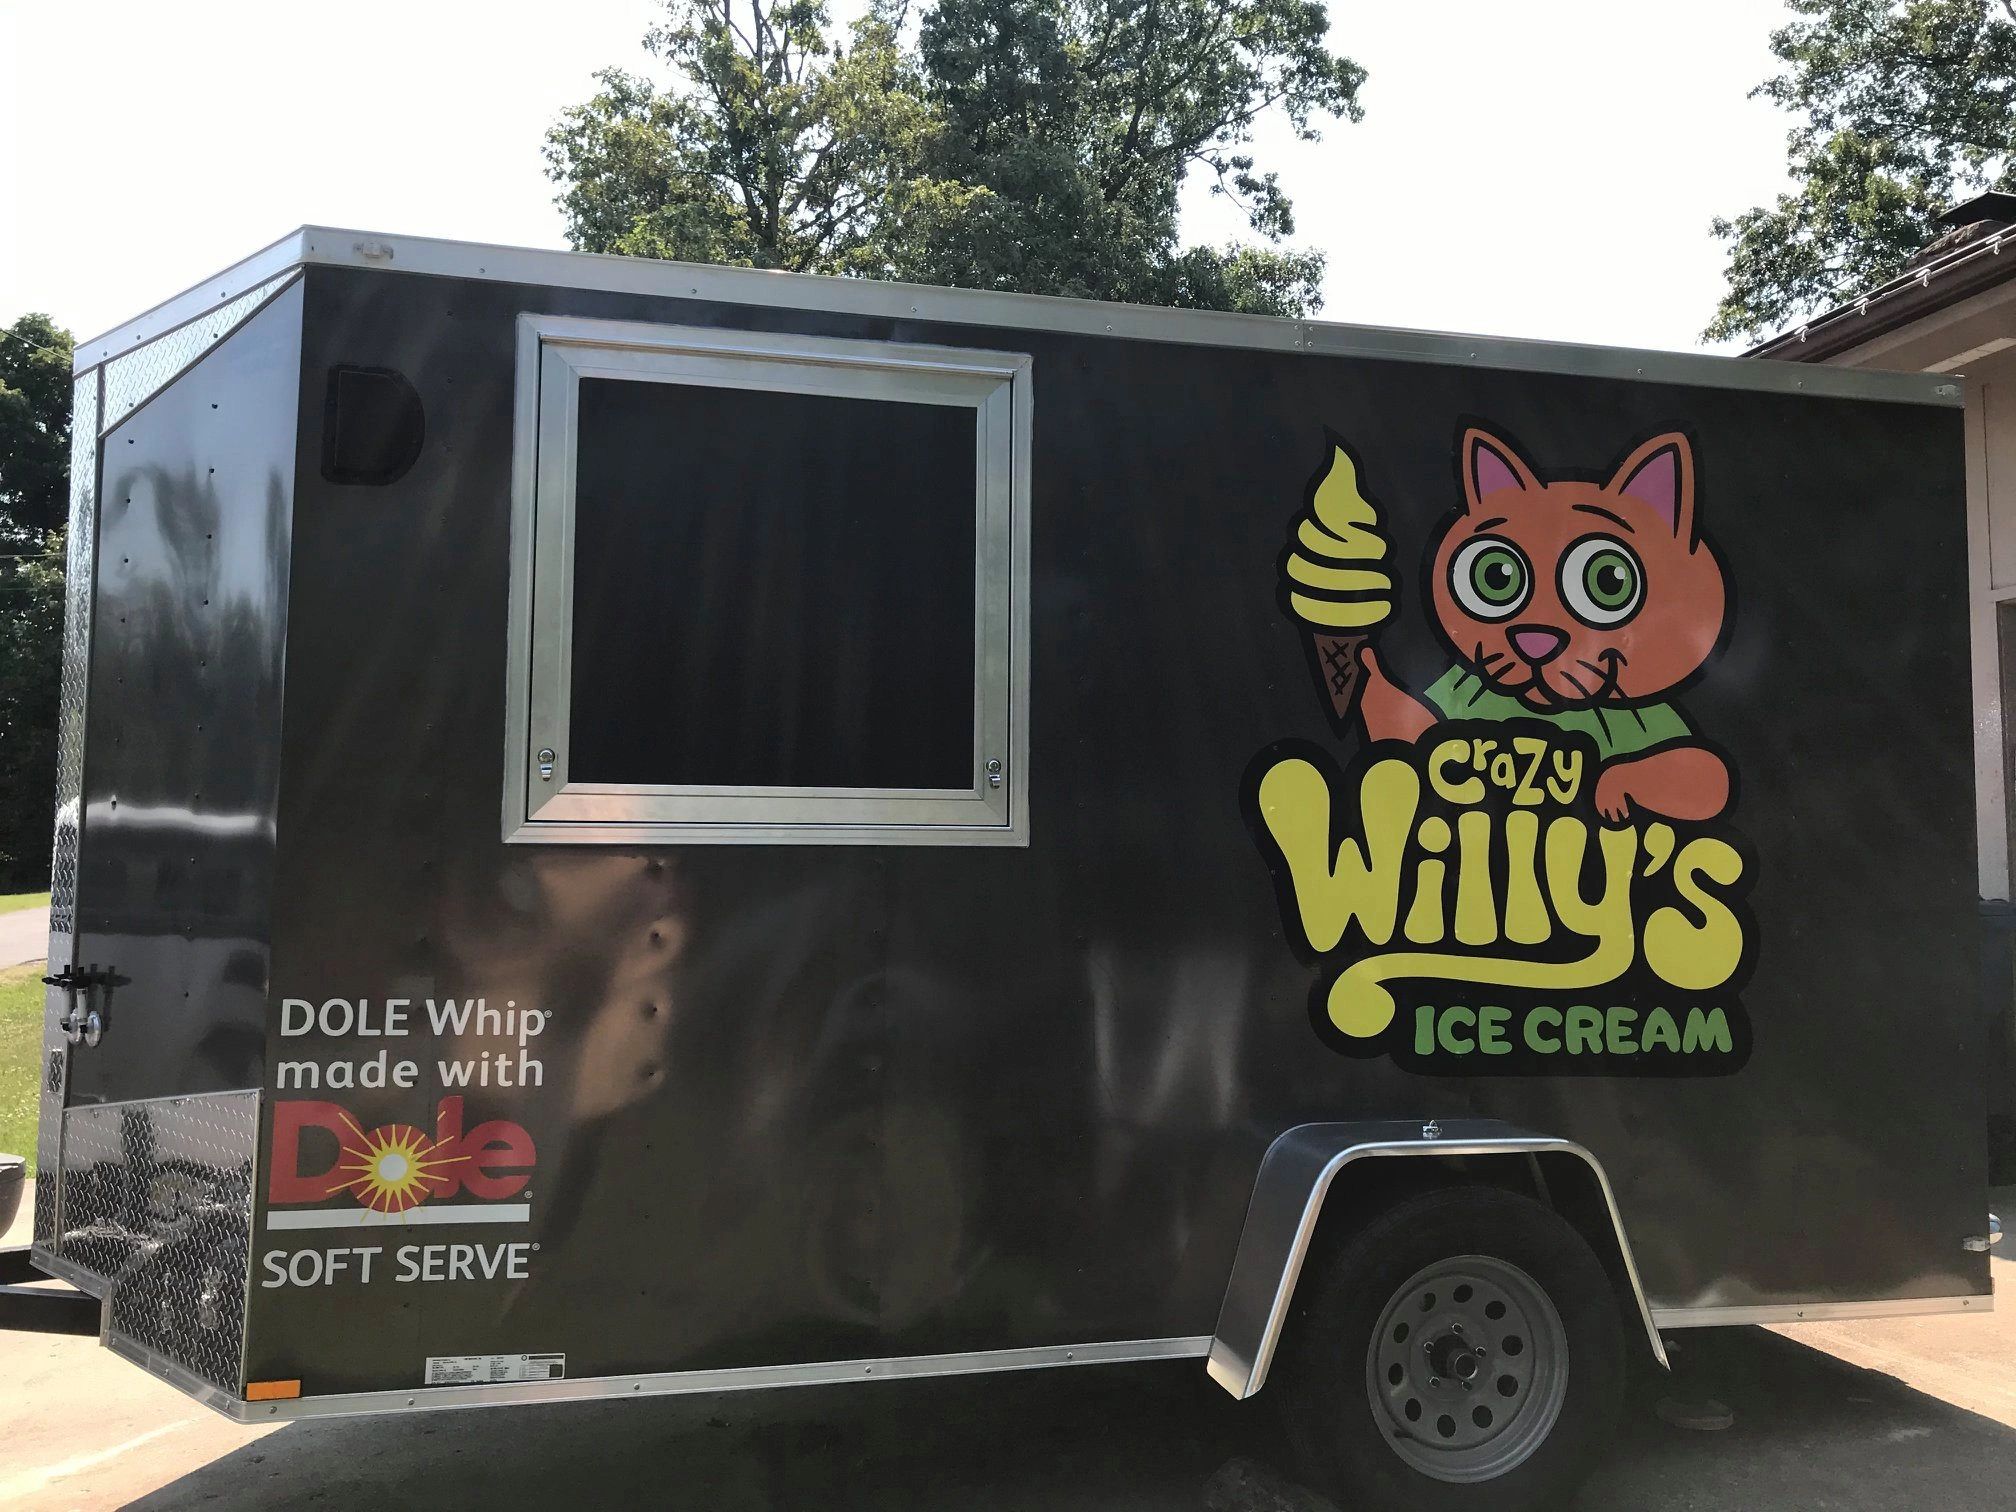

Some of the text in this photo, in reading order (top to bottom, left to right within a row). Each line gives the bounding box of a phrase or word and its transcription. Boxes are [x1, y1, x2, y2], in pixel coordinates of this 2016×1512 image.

[1259, 758, 1743, 1038] Willy's
[280, 998, 411, 1037] DOLE
[1414, 1005, 1733, 1055] ICE CREAM
[276, 1049, 544, 1089] made with
[268, 1095, 537, 1213] Dole
[261, 1246, 383, 1288] SOFT
